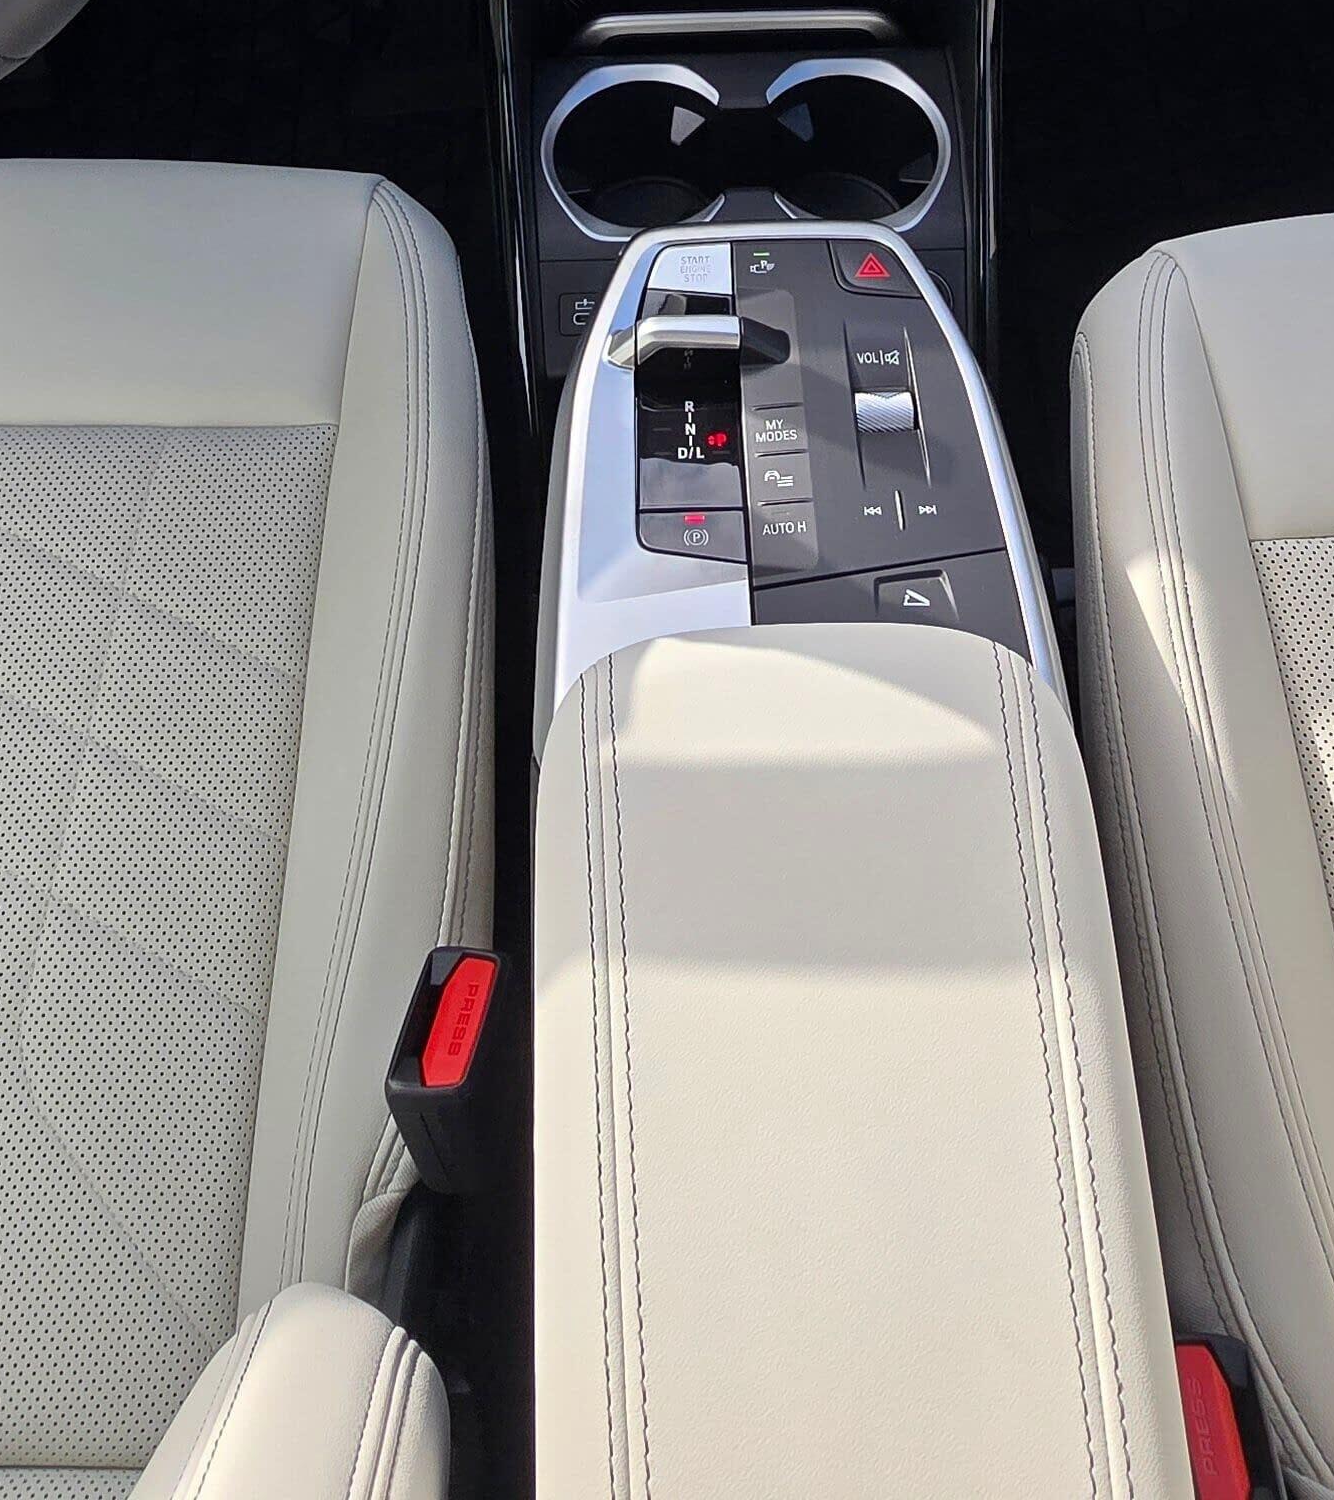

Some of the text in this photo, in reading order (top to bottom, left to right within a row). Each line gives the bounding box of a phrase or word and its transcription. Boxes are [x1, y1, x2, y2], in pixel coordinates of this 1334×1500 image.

[680, 255, 711, 265] START
[679, 264, 712, 274] ENGINE
[683, 273, 708, 284] STOP
[856, 351, 879, 365] VOL
[684, 400, 696, 413] R
[684, 423, 697, 436] N
[765, 418, 785, 432] MY
[755, 428, 798, 443] MODES
[762, 521, 807, 537] AUTO H
[447, 980, 480, 1057] PRESS
